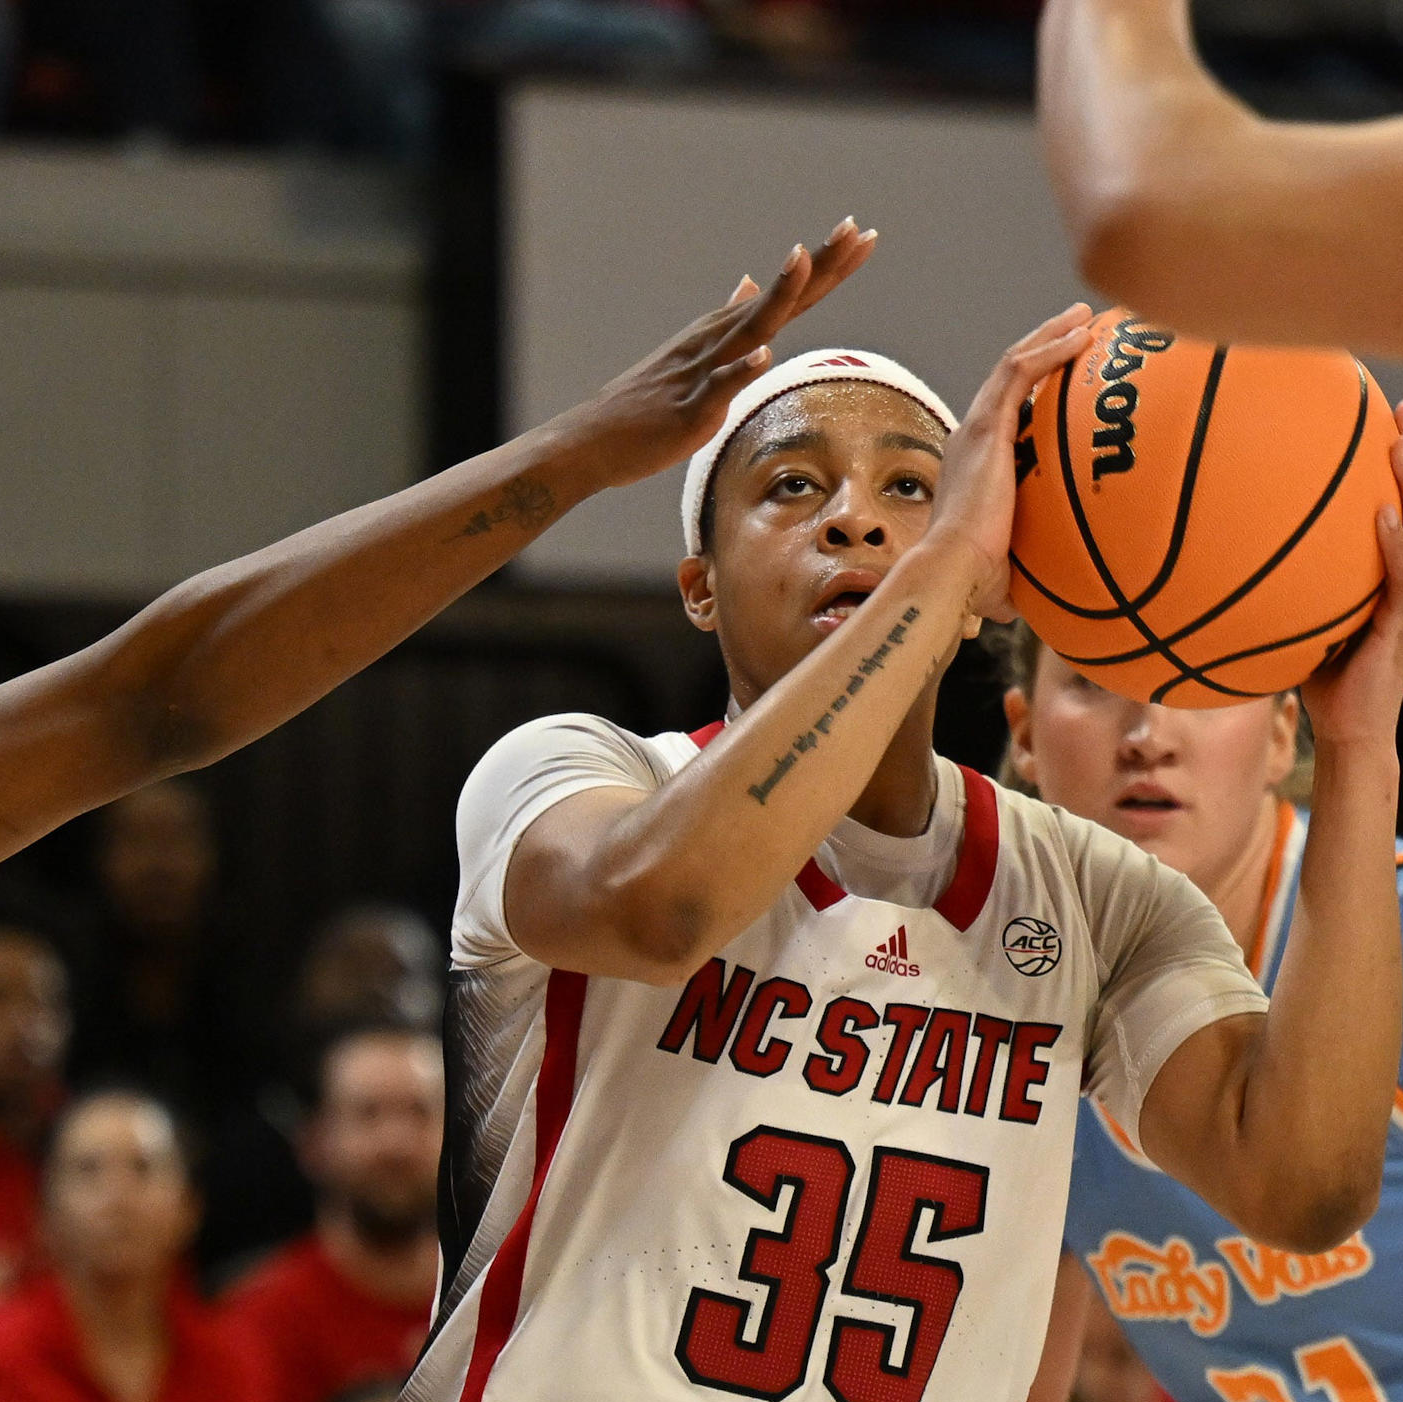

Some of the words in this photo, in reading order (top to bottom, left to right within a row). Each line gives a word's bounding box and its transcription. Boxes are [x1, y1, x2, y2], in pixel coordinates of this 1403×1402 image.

[1094, 318, 1175, 482] lson
[865, 953, 921, 977] adidas
[1010, 935, 1057, 950] ACC
[657, 956, 813, 1078] NC
[802, 996, 1064, 1126] STATE
[1088, 1232, 1230, 1337] Lady
